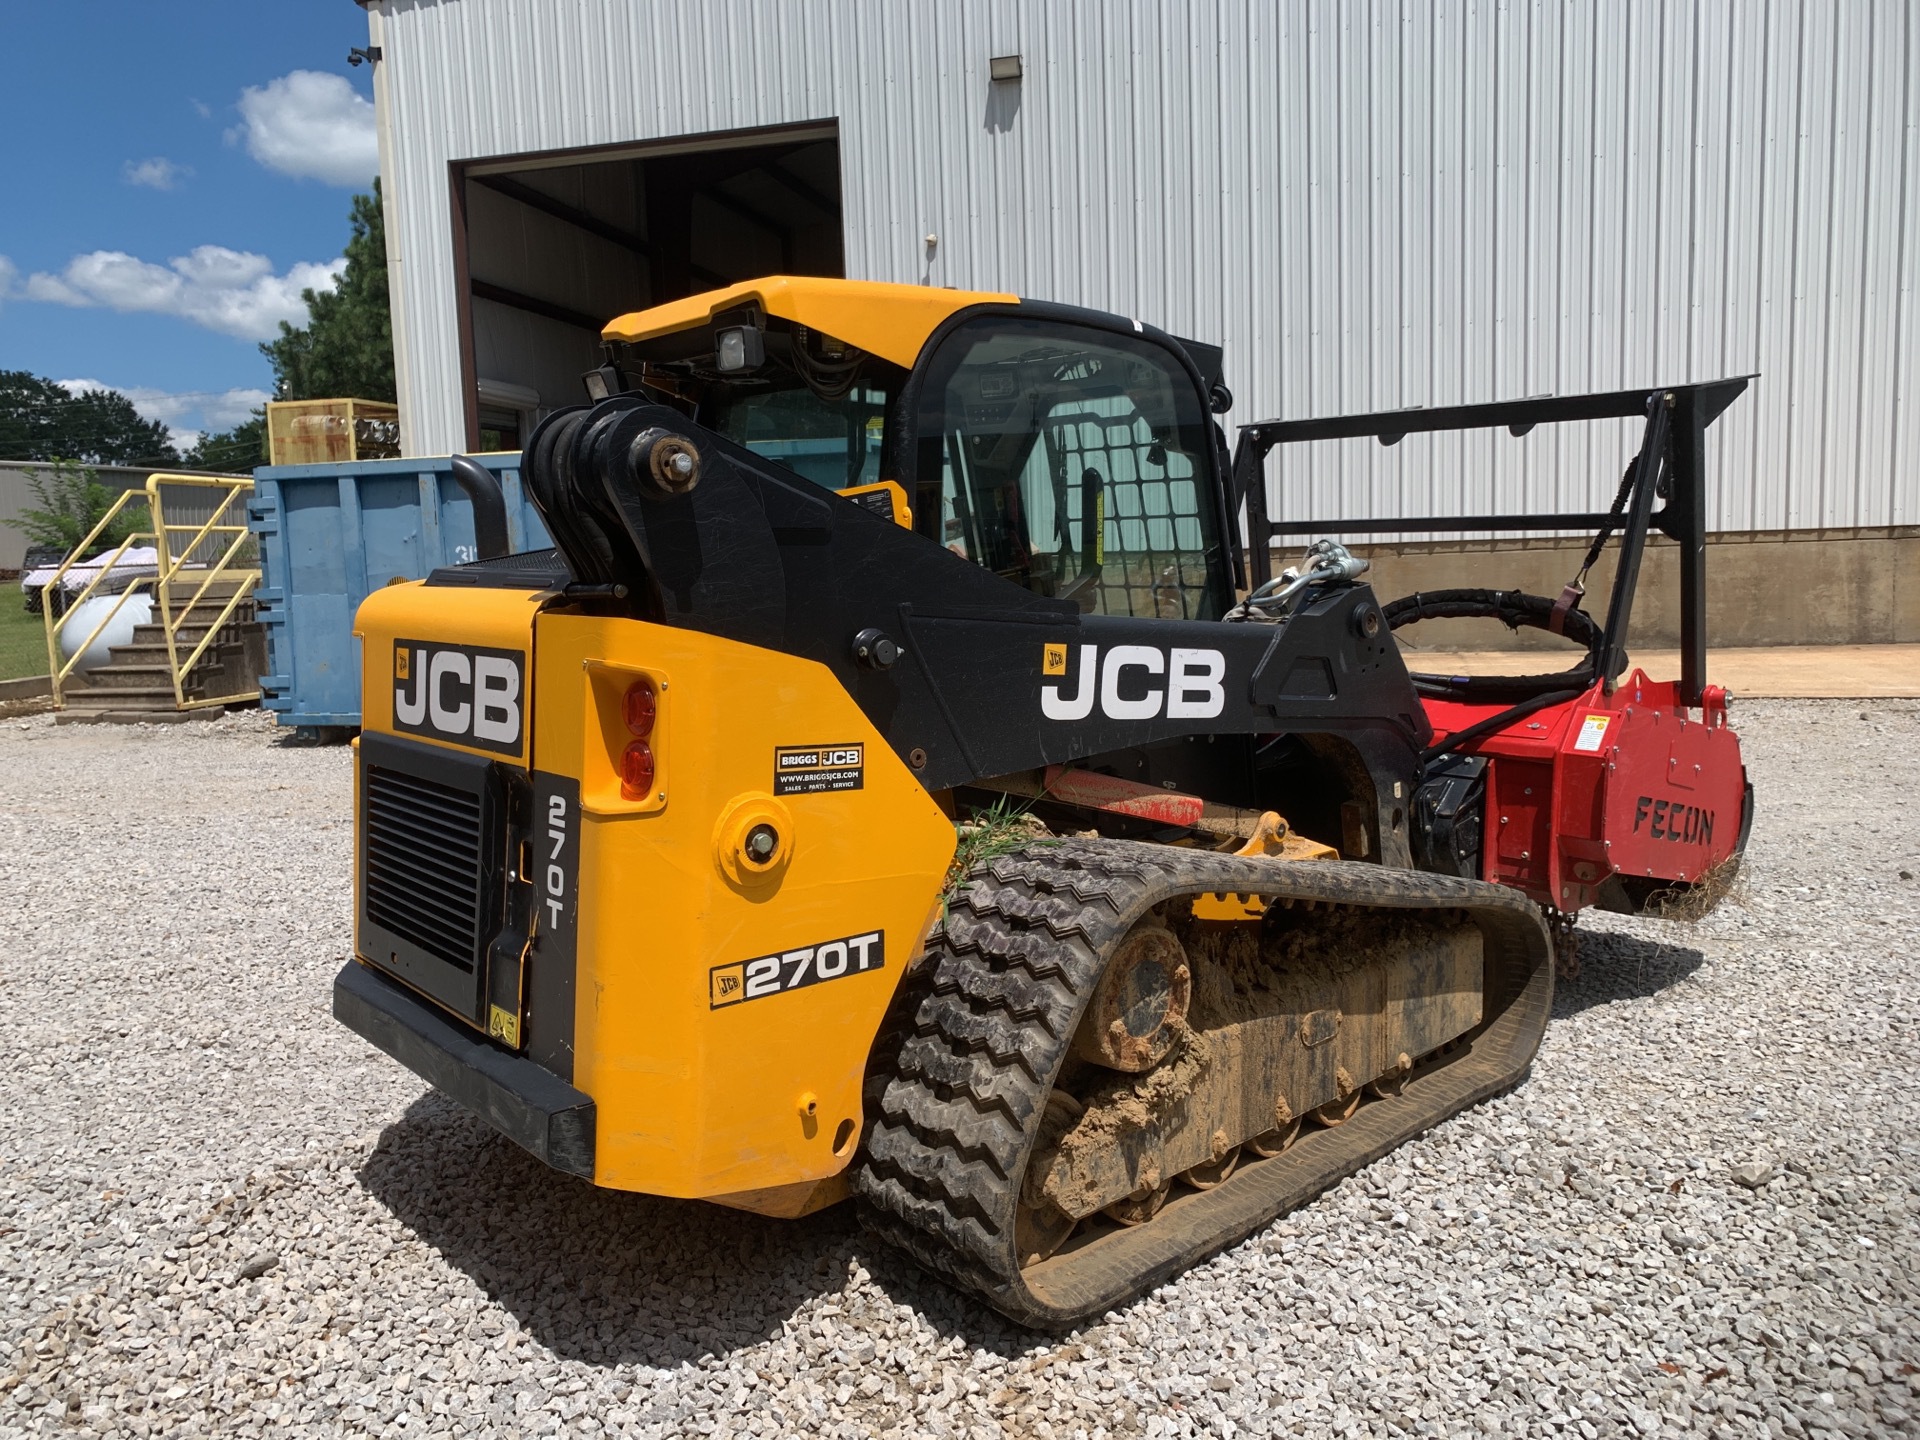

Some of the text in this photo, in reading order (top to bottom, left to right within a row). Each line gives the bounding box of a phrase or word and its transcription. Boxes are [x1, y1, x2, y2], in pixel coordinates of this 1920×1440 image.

[455, 545, 477, 564] 31
[395, 649, 520, 745] JCB
[1041, 644, 1226, 721] JCB
[780, 771, 859, 783] WWW.BRIGGSJCB.COM
[781, 751, 859, 765] BRIGGS JCB
[832, 781, 854, 789] SERVICE
[1632, 795, 1716, 846] FECON
[546, 794, 566, 930] 270T
[720, 933, 879, 998] JCB 270T
